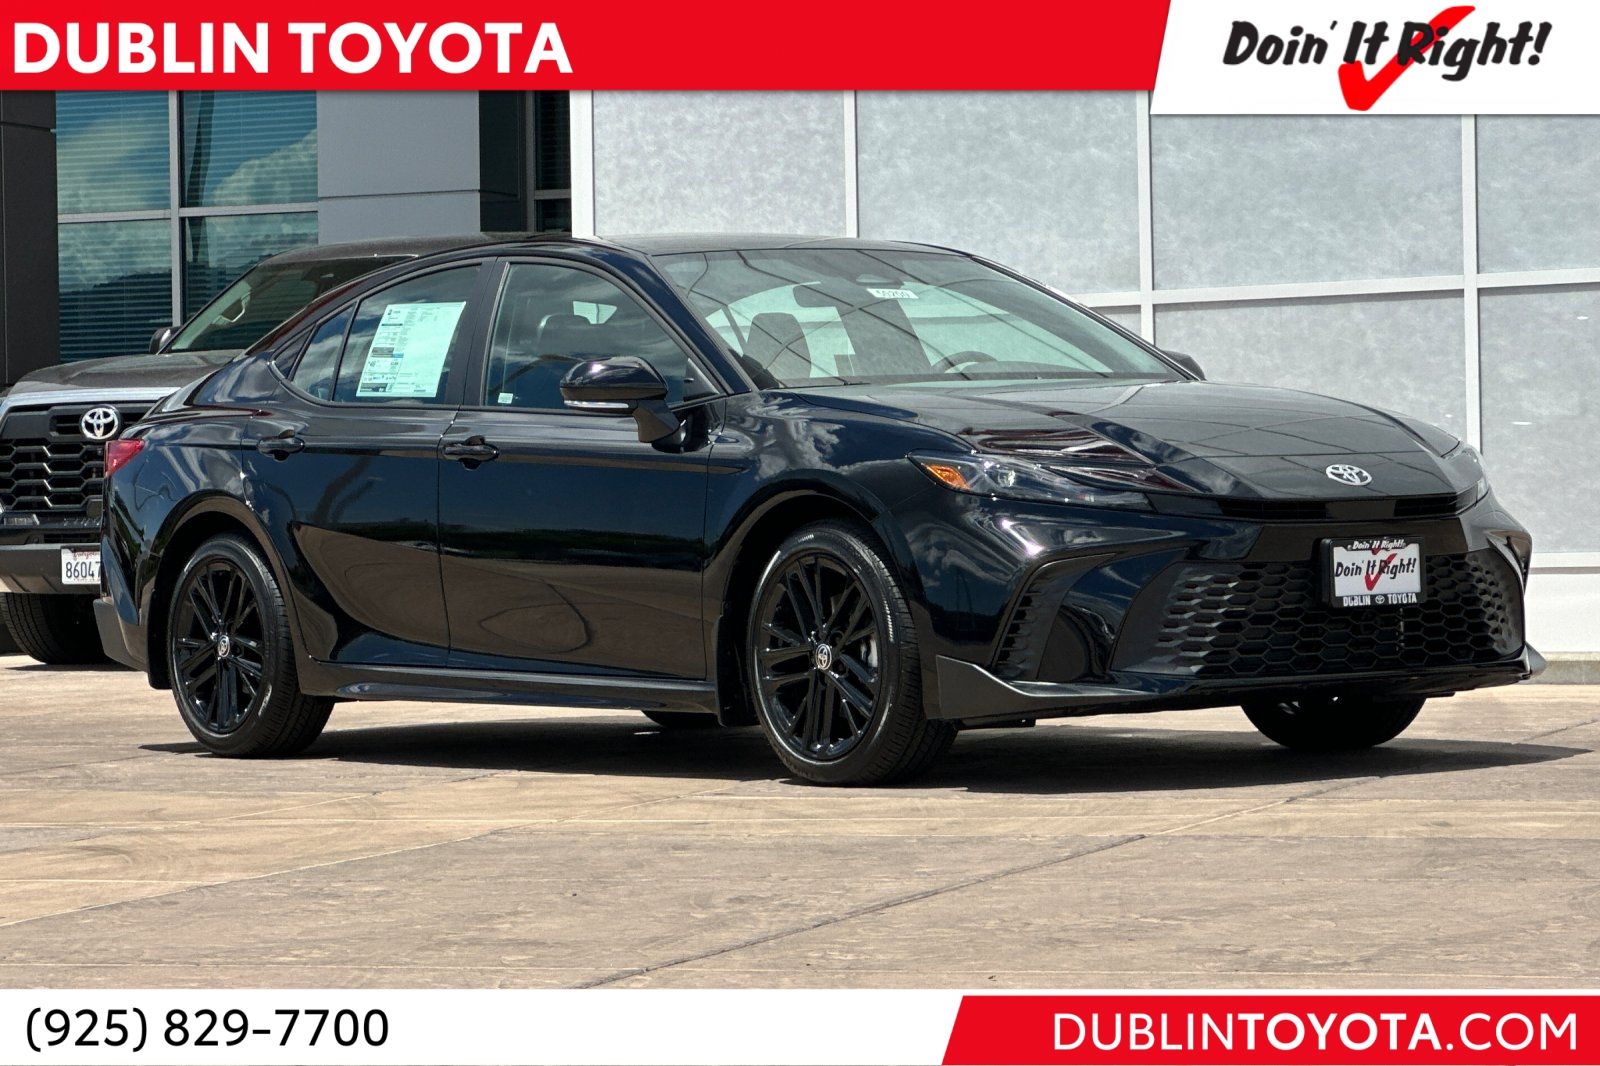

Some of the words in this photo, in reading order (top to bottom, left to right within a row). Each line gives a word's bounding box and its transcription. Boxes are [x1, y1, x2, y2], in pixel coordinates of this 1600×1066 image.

[1380, 539, 1405, 551] Right!
[1335, 560, 1364, 577] Doin'
[1366, 560, 1377, 575] It
[1379, 558, 1417, 579] Right!
[1343, 595, 1371, 607] DUBLIN
[1387, 593, 1418, 604] TOYOTA
